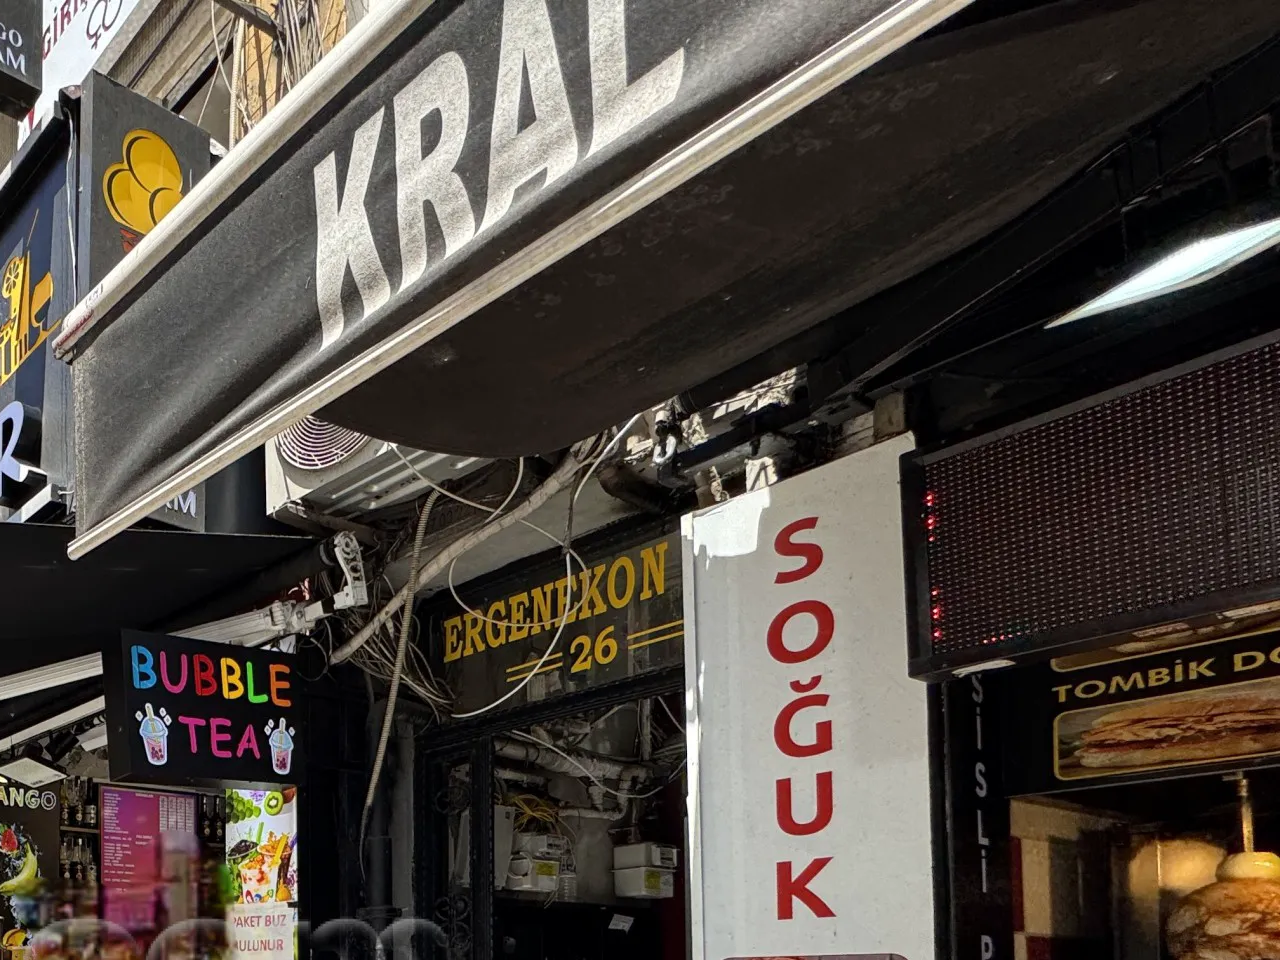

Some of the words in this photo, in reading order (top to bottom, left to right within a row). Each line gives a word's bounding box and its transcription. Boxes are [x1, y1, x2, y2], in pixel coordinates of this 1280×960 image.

[312, 0, 687, 353] KRAL
[443, 541, 668, 664] ERGENEKON
[130, 645, 292, 708] BUBBLE
[570, 625, 618, 674] 26
[1052, 657, 1217, 703] TOMBİK
[1233, 645, 1280, 673] D
[178, 715, 261, 760] TEA
[766, 516, 837, 921] SOĞUK
[233, 915, 262, 928] AKET
[264, 913, 288, 926] BUZ
